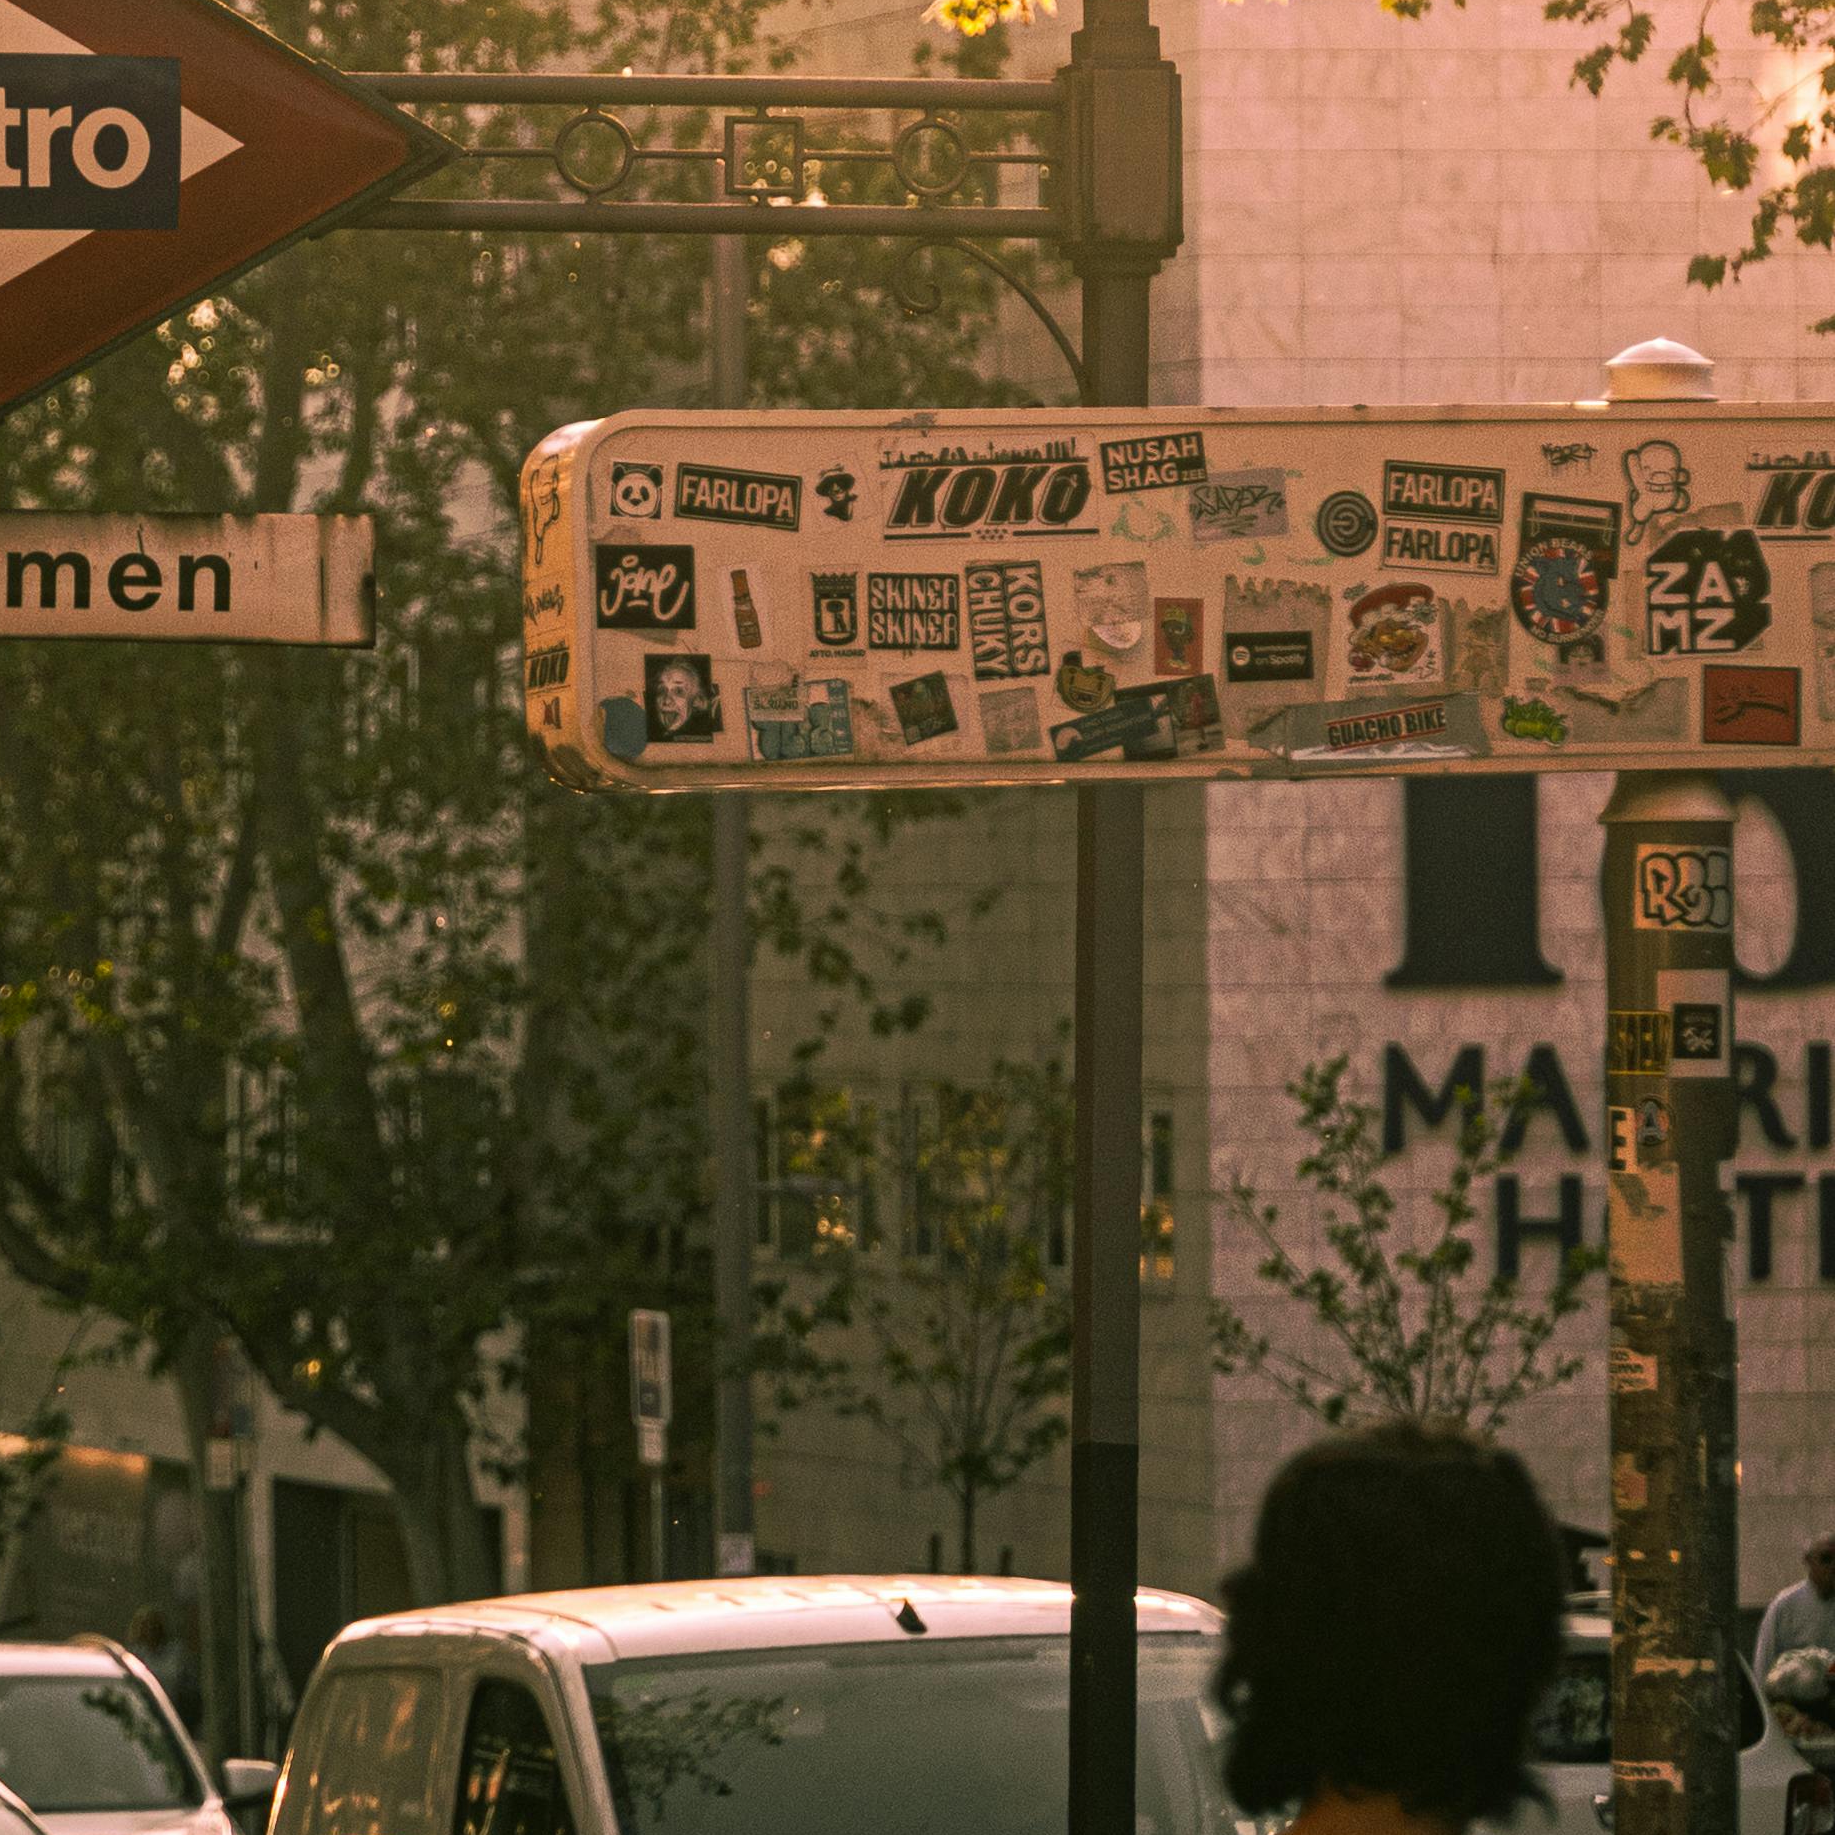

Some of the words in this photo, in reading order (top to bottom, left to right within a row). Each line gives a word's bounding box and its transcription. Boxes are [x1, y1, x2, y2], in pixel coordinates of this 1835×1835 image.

[1107, 435, 1199, 466] NUSAH
[1108, 462, 1178, 490] SHAG
[1389, 472, 1499, 511] FARLOPA
[681, 475, 795, 518] FARLOPA
[887, 465, 1092, 528] KOKO
[1386, 526, 1496, 564] FARLOPA
[870, 578, 958, 610] SKINER
[871, 612, 958, 645] SKINER
[968, 569, 1010, 671] CHUKY
[1005, 566, 1047, 673] KORS
[1328, 714, 1402, 747] GUACHO
[1405, 707, 1445, 733] BIKE
